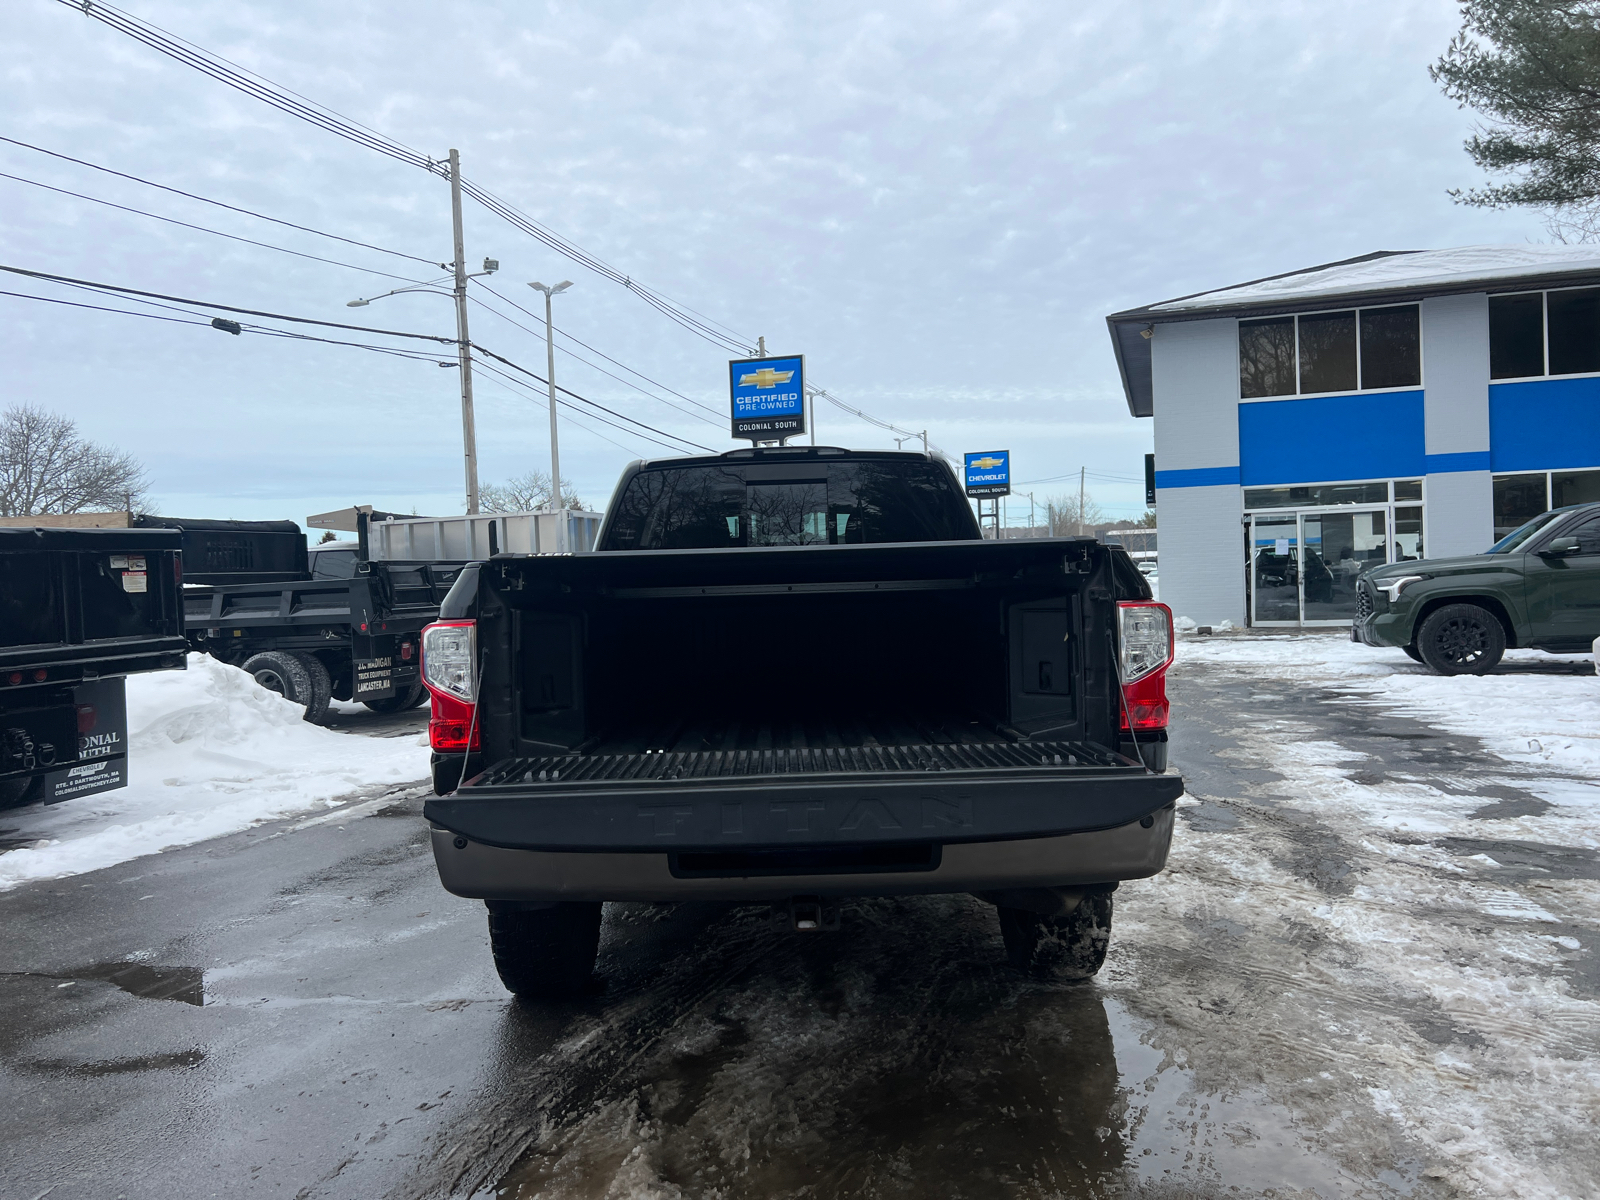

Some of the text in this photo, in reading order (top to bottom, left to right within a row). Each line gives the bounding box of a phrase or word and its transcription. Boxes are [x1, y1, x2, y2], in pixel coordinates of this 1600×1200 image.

[736, 393, 798, 404] CERTIFIED
[739, 401, 795, 411] PRE-OWNED
[738, 421, 797, 431] COLONIAL SOUTH
[968, 474, 1006, 482] CHEVROLET
[358, 670, 391, 680] TRUCK EQUIPMENT
[80, 732, 120, 748] ONIAL
[72, 762, 105, 774] CHEVROLET
[55, 782, 69, 790] RTE.
[55, 777, 120, 796] COLONIALSOUTHCHEVY.COM
[637, 793, 974, 836] TITAN
